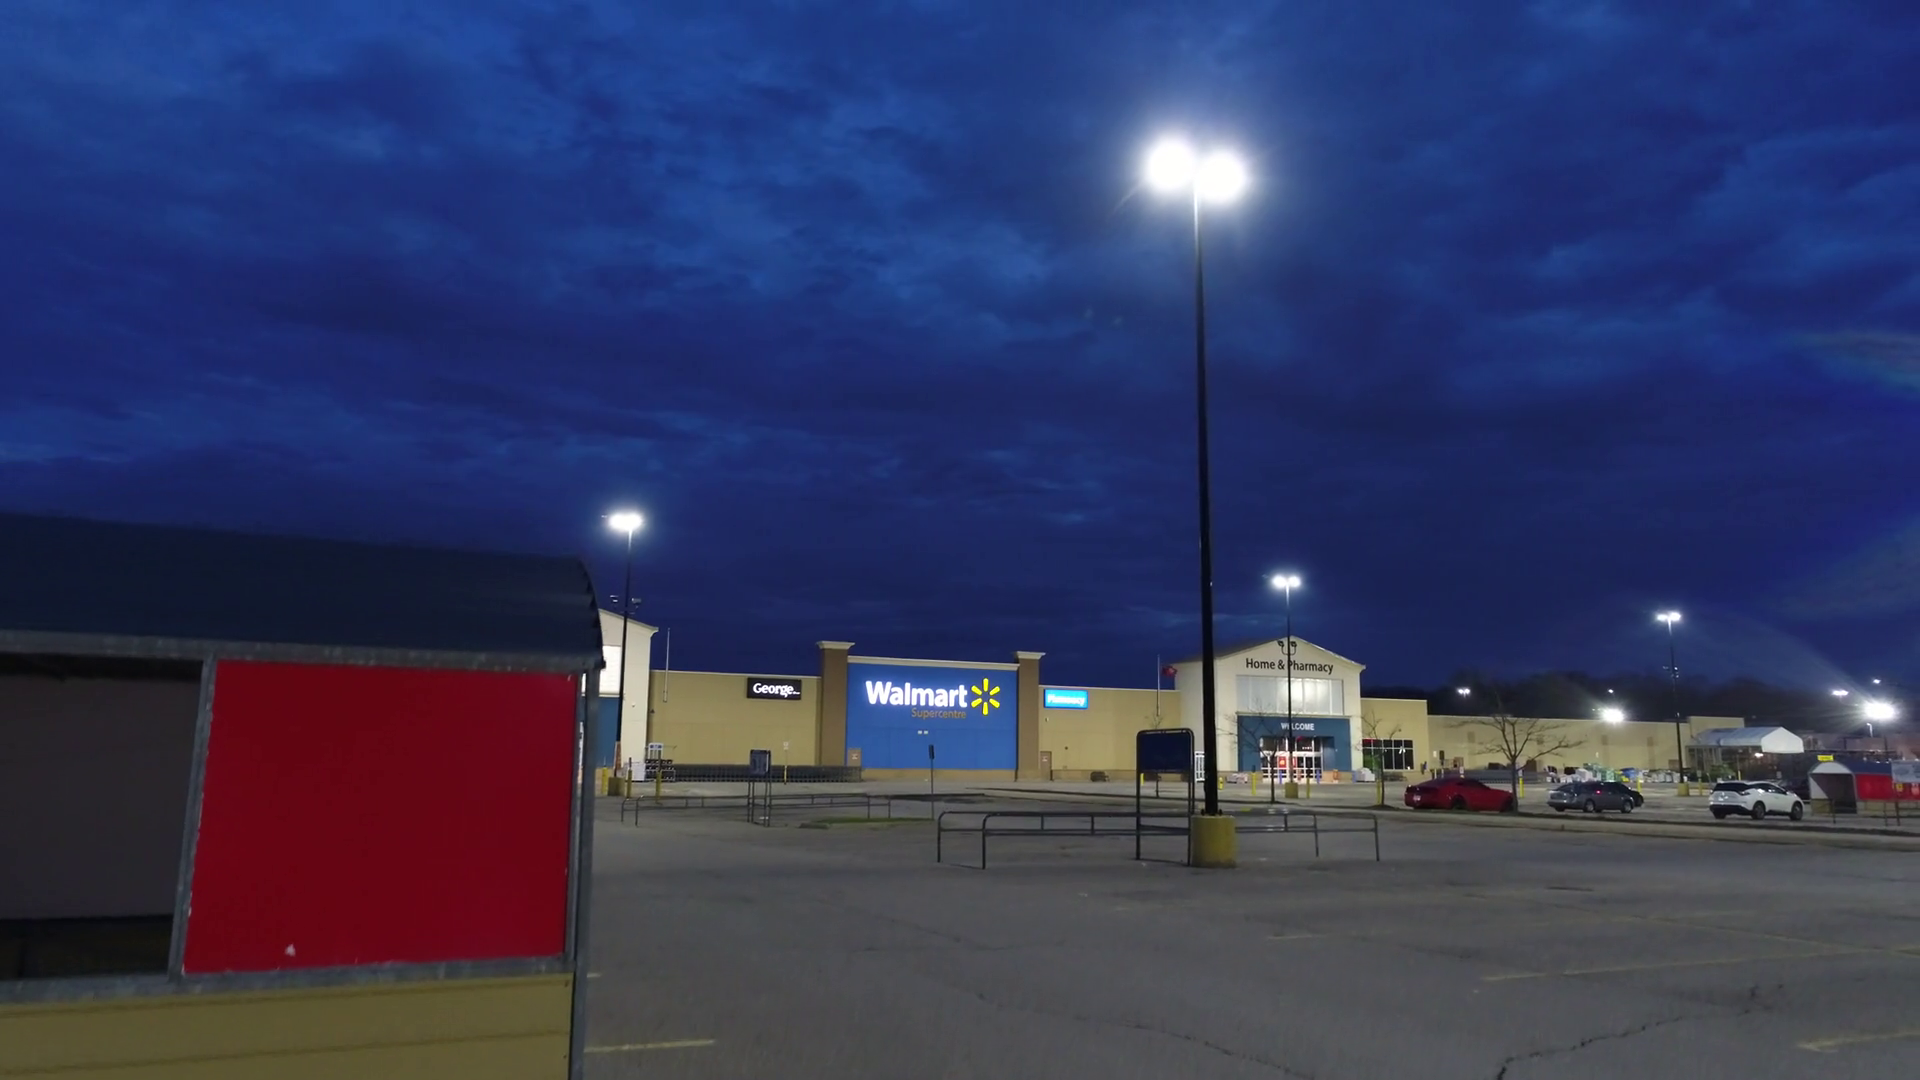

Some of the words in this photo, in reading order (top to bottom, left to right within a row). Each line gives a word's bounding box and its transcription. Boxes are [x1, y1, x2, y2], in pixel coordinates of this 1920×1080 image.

[1246, 658, 1275, 669] Home
[1277, 659, 1285, 670] &
[1288, 660, 1333, 675] Pharmacy
[752, 682, 794, 698] George
[865, 680, 968, 708] Walmart
[911, 707, 967, 720] Supercentre
